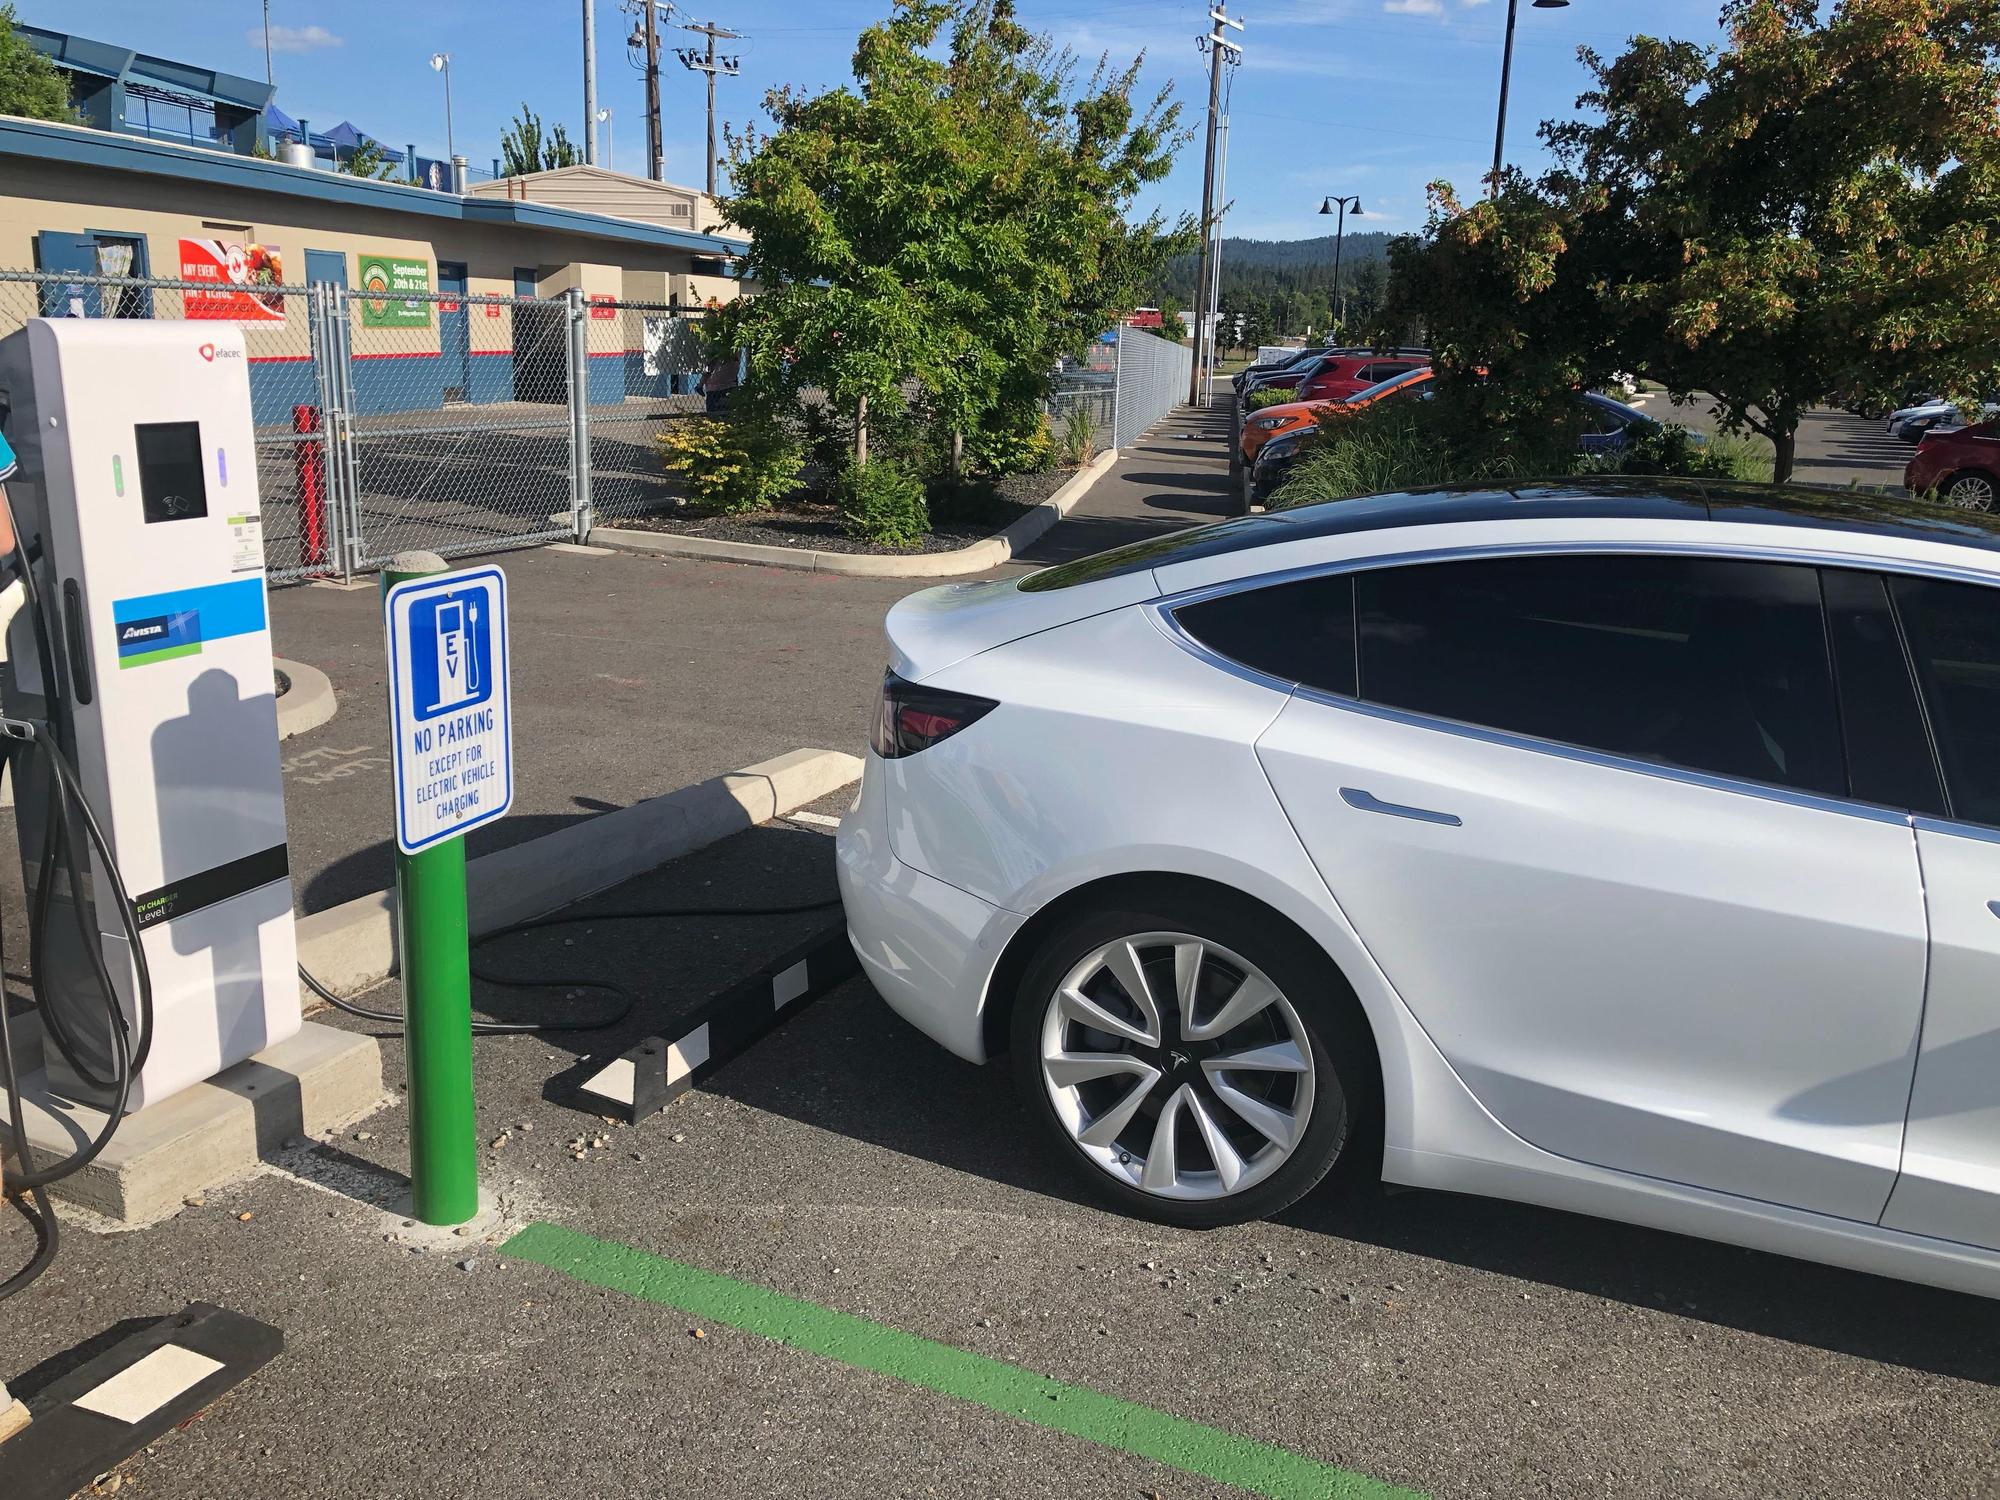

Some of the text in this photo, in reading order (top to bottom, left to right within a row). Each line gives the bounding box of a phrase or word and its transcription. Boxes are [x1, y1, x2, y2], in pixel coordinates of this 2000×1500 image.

[183, 263, 196, 276] ANY
[393, 264, 426, 277] September
[394, 278, 428, 291] 20th & 21st
[215, 347, 241, 359] efacec
[122, 624, 162, 640] AVISTA
[446, 634, 458, 678] EV
[414, 708, 493, 756] NO PARKING
[429, 744, 482, 777] EXCEPT FOR
[416, 760, 495, 804] ELECTRIC VEHICLE
[436, 789, 479, 820] CHARGING
[137, 892, 178, 913] EV CHARGER
[138, 901, 174, 924] Level 2
